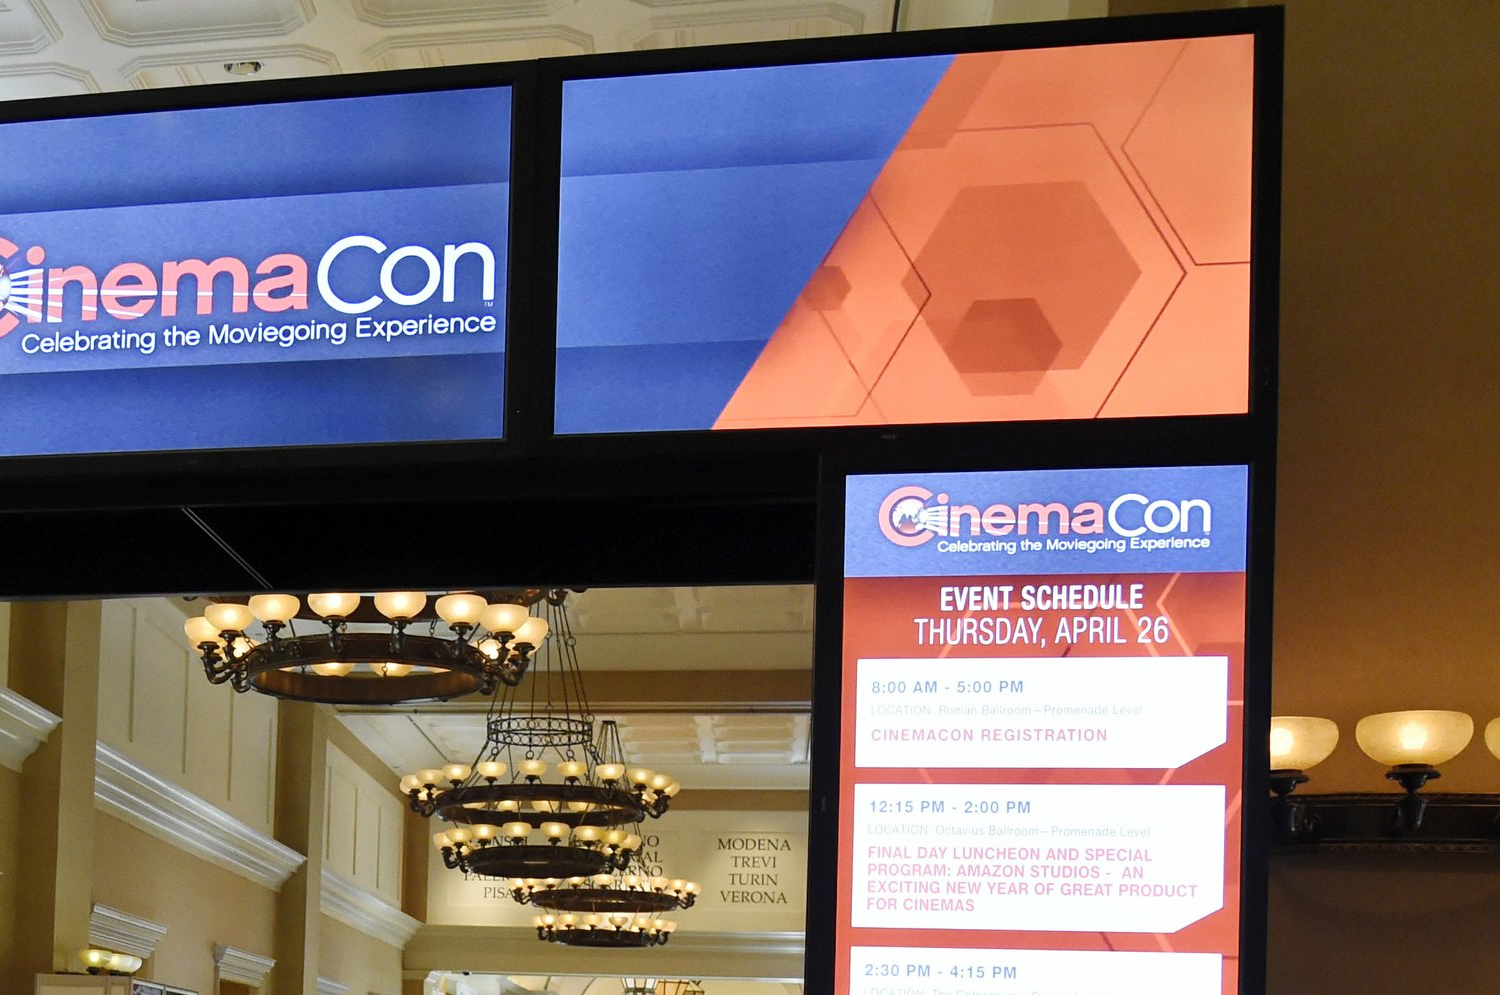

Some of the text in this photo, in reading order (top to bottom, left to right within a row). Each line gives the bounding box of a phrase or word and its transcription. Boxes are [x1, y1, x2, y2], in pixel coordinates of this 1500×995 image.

[21, 315, 496, 355] Celebrating the Moviegoing Experience
[878, 486, 1211, 547] CinemaCon
[938, 536, 1210, 554] Celebrating the Moviegoing Experience
[941, 584, 1143, 614] EVENT SCHEDULE
[914, 615, 1170, 648] THURSDAY, APRIL 26
[872, 681, 906, 693] 8:00
[913, 681, 937, 693] AM
[958, 681, 992, 693] 5:00
[1000, 680, 1023, 692] PM
[872, 729, 1106, 741] CINEMACON REGISTRATION
[870, 801, 913, 813] 12:15
[921, 800, 944, 812] PM
[964, 801, 999, 813] 2:00
[1006, 801, 1030, 814] PM
[717, 838, 791, 851] MODENA
[868, 846, 1152, 861] FINAL DAY LUNCHEON AND SPECIAL
[731, 856, 776, 868] TREVI
[728, 873, 778, 885] TURIN
[868, 864, 950, 876] PROGRAM:
[957, 864, 1024, 878] AMAZON
[1030, 865, 1100, 878] STUDIOS
[1122, 866, 1143, 879] AN
[868, 880, 1198, 897] EXCITING NEW YEAR OF GREAT PRODUCT
[720, 891, 787, 903] VERONA
[867, 898, 974, 912] FOR CINEMAS
[865, 964, 899, 976] 2:30
[907, 964, 930, 976] PM
[950, 966, 984, 978] 4:15
[993, 966, 1016, 979] PM
